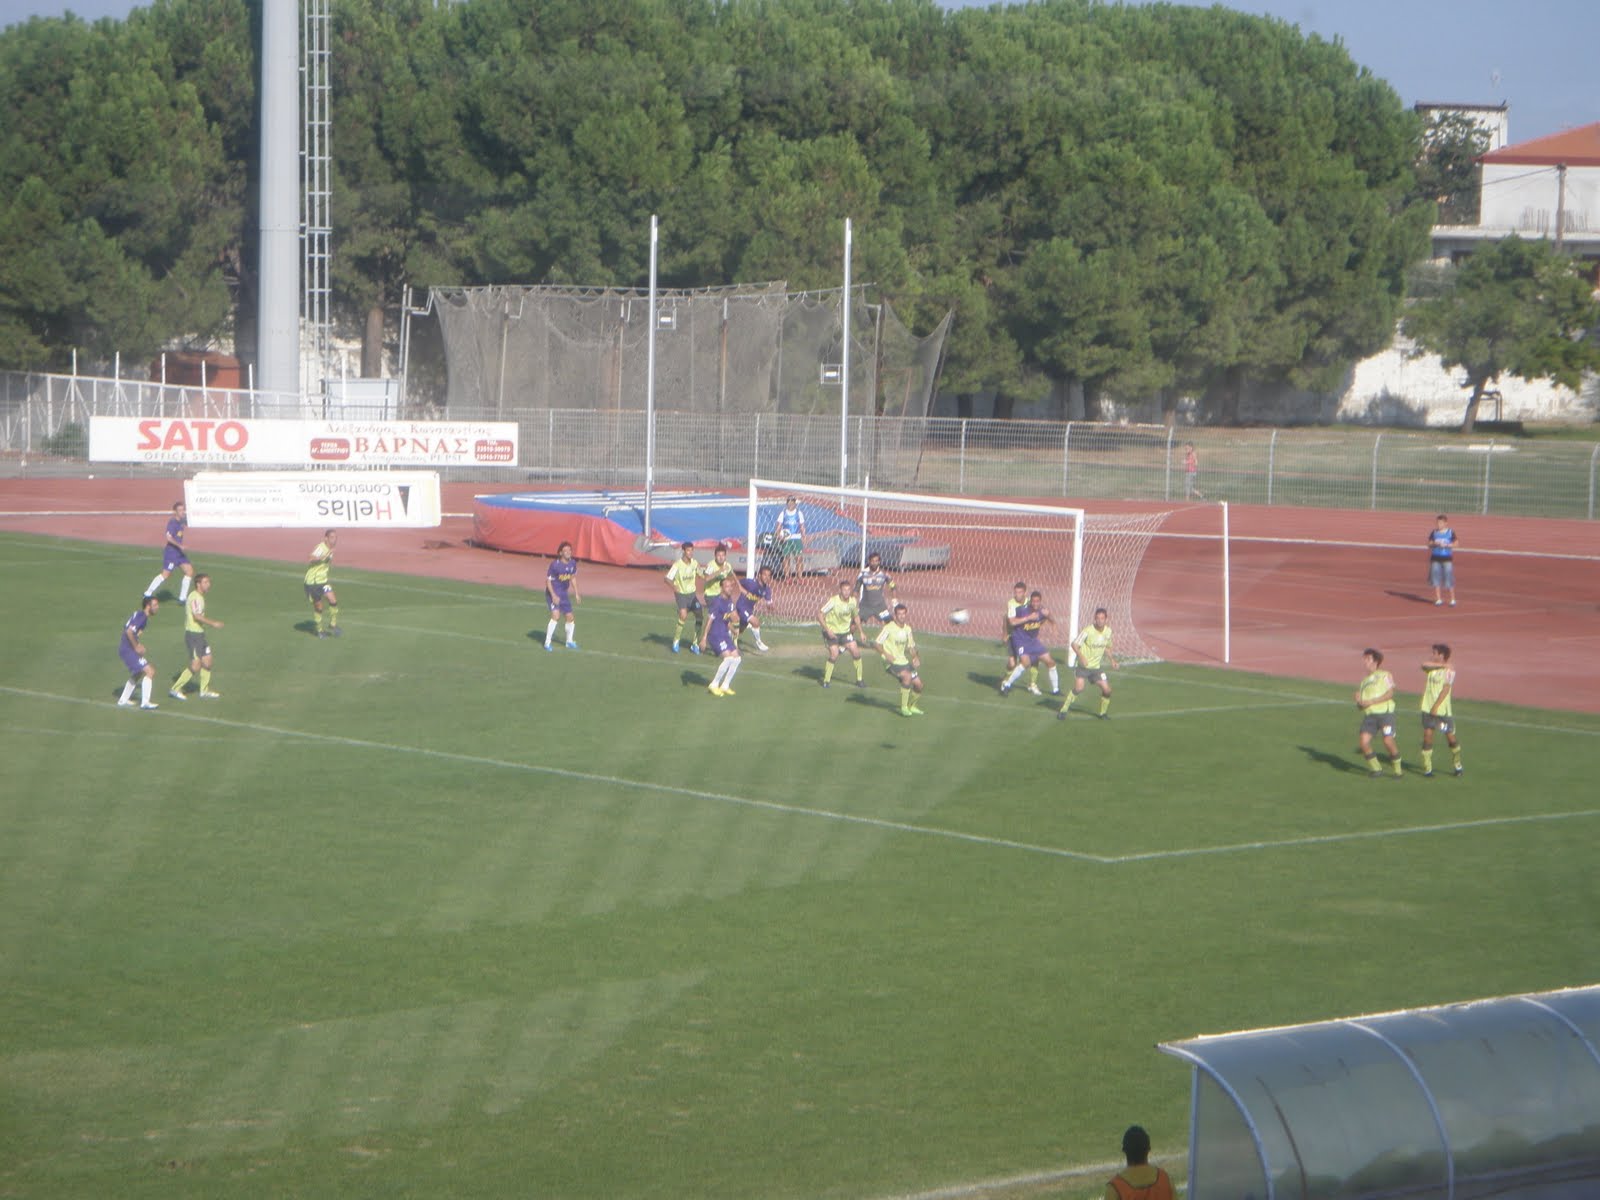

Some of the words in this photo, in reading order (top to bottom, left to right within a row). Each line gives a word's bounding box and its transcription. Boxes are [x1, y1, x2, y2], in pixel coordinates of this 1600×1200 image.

[138, 420, 249, 451] SATO
[355, 438, 468, 453] ΒΑΡΝΑΣ
[145, 452, 186, 460] OFFICE
[192, 453, 246, 461] SYSTEMS
[299, 484, 391, 496] Constructions
[316, 499, 392, 521] Hellas
